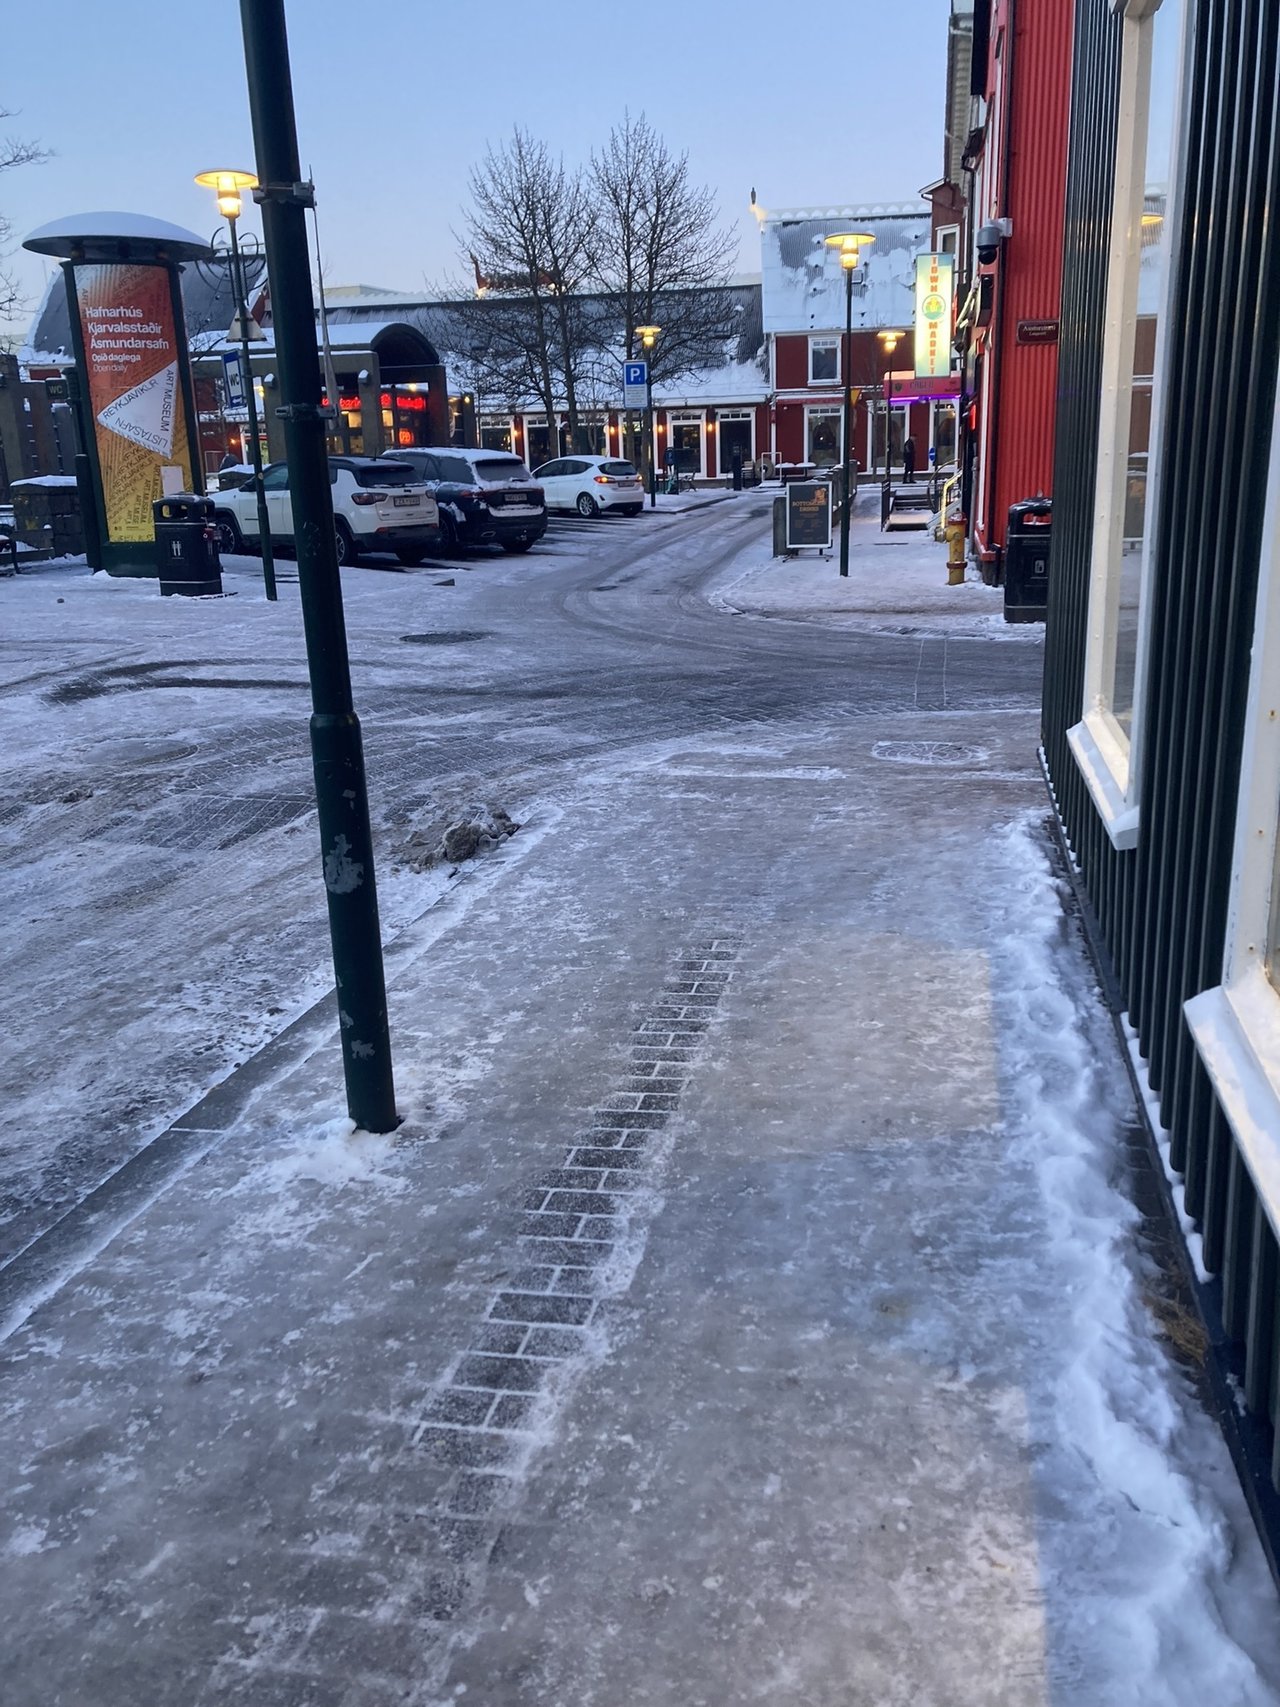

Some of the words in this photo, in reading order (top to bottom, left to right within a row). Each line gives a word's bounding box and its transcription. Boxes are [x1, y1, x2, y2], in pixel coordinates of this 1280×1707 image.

[929, 256, 939, 293] TOWN
[85, 305, 143, 318] Hafnarhús
[87, 321, 163, 335] Kjarvalsstaðir
[90, 334, 169, 349] Ásmundarsafn
[929, 321, 938, 375] MARKET
[91, 353, 107, 363] Opið
[108, 353, 140, 363] daglega
[93, 364, 111, 373] Open
[630, 367, 640, 382] P
[166, 369, 174, 387] ART
[229, 373, 239, 387] WC
[49, 385, 63, 394] WC
[102, 379, 159, 420] REYKJAVIKUR
[160, 388, 172, 432] MUSEUM
[115, 417, 168, 448] LISTASAFN
